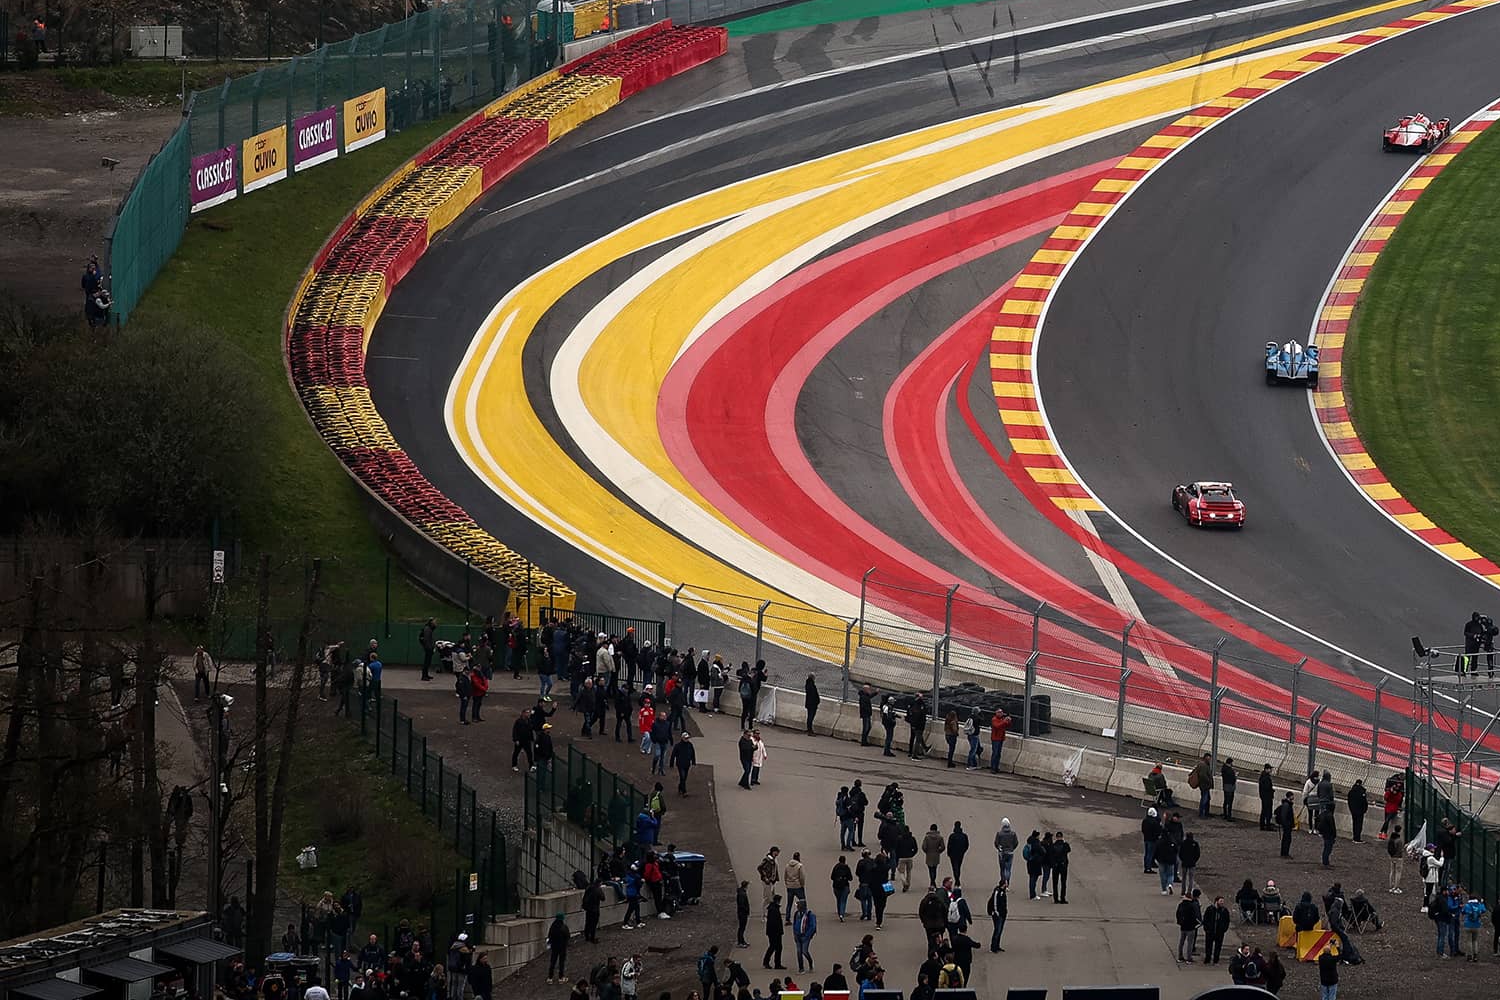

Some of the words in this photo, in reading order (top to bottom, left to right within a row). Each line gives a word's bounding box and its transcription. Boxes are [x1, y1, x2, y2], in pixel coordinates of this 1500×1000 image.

[299, 122, 325, 150] CLASSIC
[325, 118, 333, 141] 21
[355, 110, 377, 133] auvio
[196, 161, 225, 191] CLASSIC
[225, 158, 233, 180] 21
[254, 148, 277, 173] auvio
